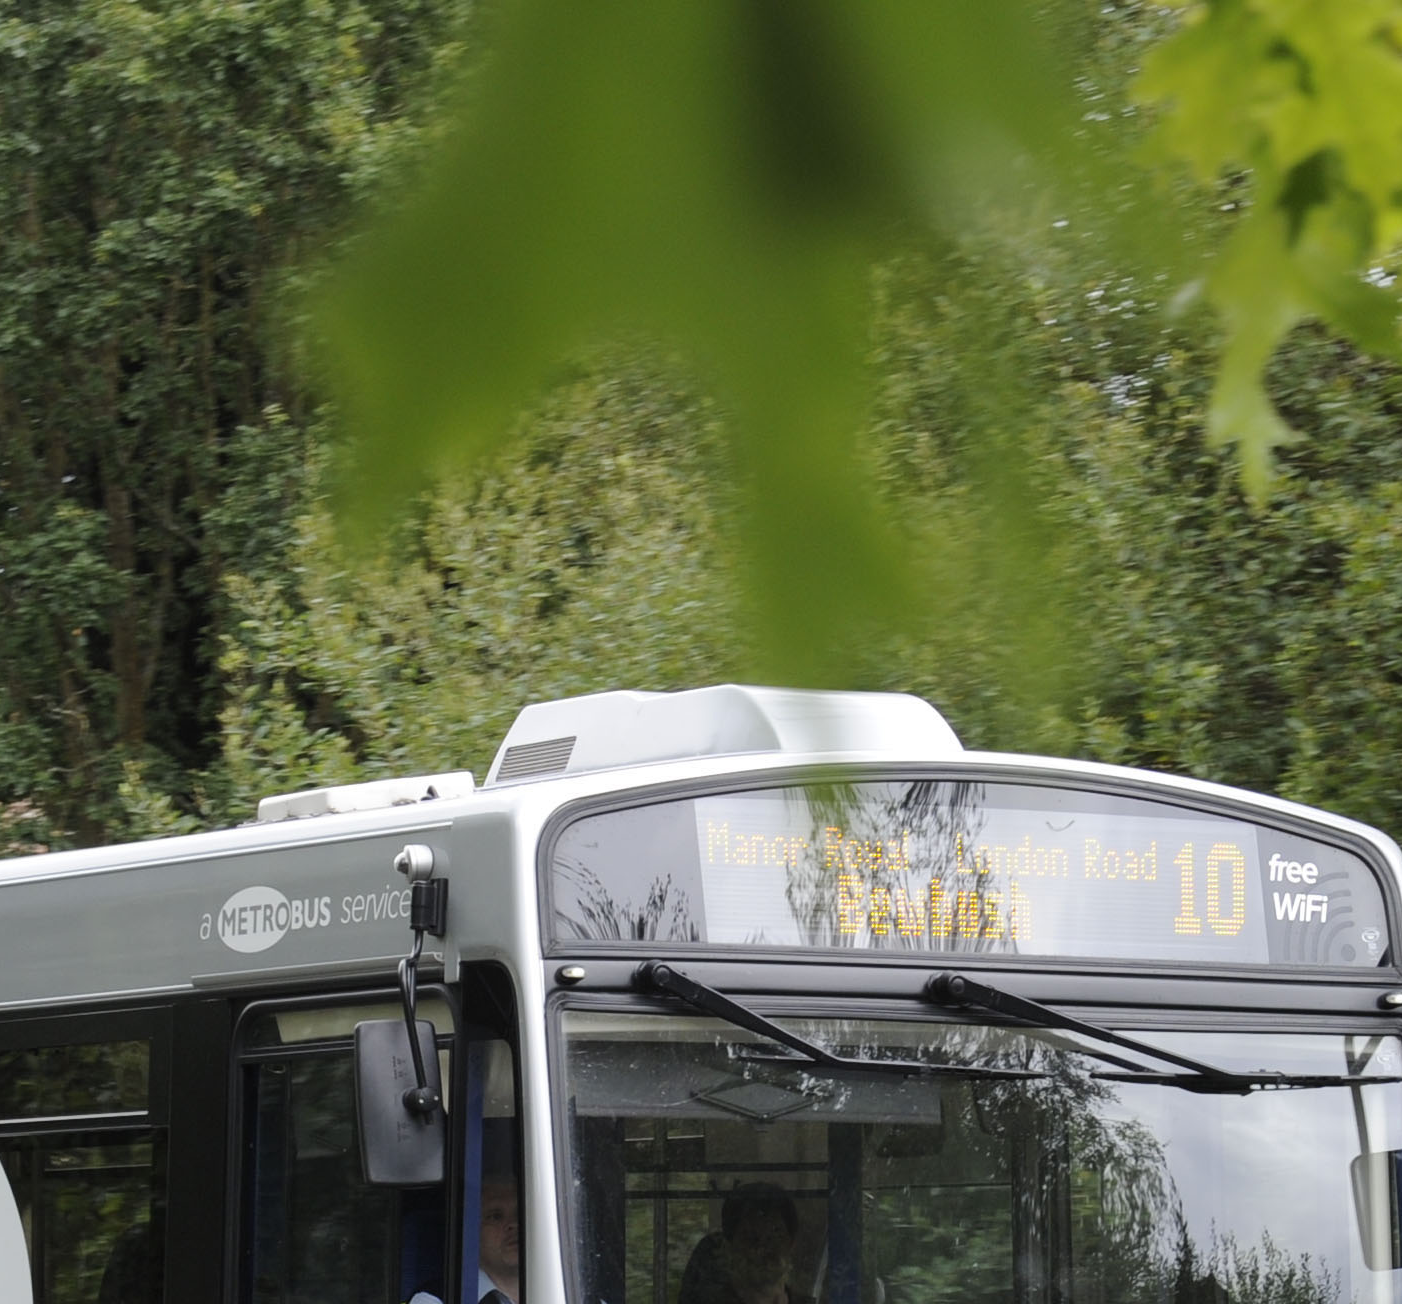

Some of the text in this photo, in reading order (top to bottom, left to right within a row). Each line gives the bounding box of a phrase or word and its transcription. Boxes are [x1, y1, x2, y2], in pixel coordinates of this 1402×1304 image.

[708, 820, 1157, 881] Manor Royal London Road
[1268, 853, 1319, 884] free
[200, 884, 413, 940] a METROBUS service
[1173, 841, 1245, 936] 10
[1273, 892, 1328, 923] WiFi
